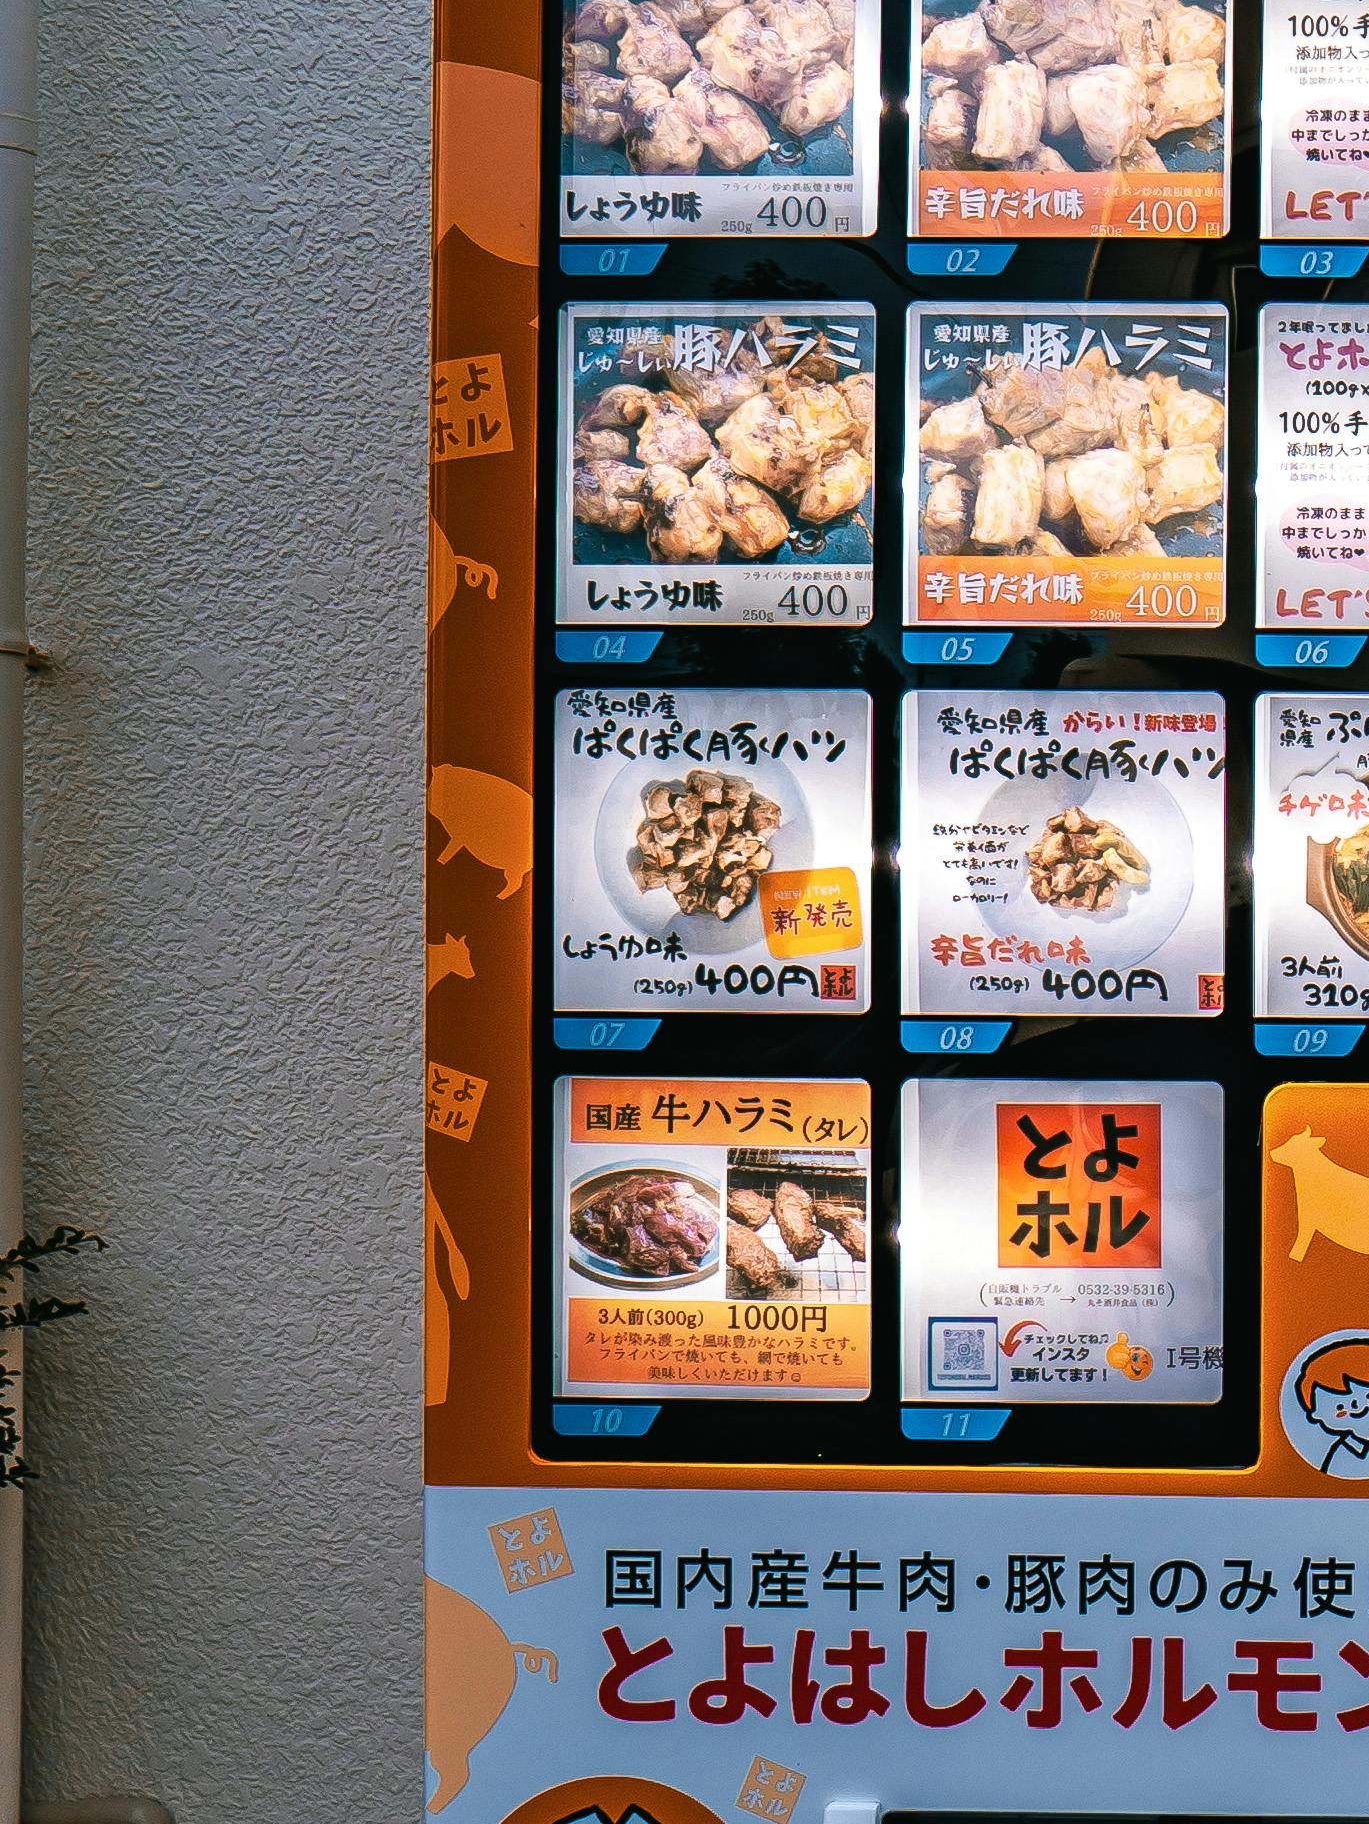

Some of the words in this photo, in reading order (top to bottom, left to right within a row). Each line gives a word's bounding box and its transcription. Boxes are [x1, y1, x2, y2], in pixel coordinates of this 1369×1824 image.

[566, 189, 703, 223] しょうゆ味
[925, 187, 1084, 220] 辛旨だれ味
[599, 247, 630, 272] 01
[947, 250, 980, 273] 02
[1301, 252, 1334, 274] 03
[672, 324, 862, 372] 豚ハラミ
[1023, 323, 1212, 371] 豚ハラミ
[1297, 507, 1366, 521] 冷凍のまま
[588, 580, 723, 612] しょうゆ味
[925, 572, 1083, 605] 辛旨だれ味
[743, 609, 774, 622] 250g
[593, 636, 626, 660] 04
[941, 638, 974, 661] 05
[1295, 640, 1329, 663] 06
[573, 721, 846, 765] ぱくぱく豚ハツ
[805, 884, 840, 897] ITEM
[966, 876, 996, 886] なのに
[770, 901, 853, 935] 新発売
[1281, 956, 1343, 979] 3人前
[634, 978, 692, 997] (250g)
[1043, 970, 1168, 1002] 400円
[589, 1022, 625, 1047] 07
[940, 1026, 973, 1050] 08
[1294, 1030, 1328, 1052] 09
[586, 1103, 641, 1131] 国産
[651, 1094, 795, 1133] 牛ハラミ
[1016, 1114, 1141, 1182] とよ
[1009, 1190, 1151, 1258] ホル
[1078, 1283, 1165, 1296] 0532-39-5316
[727, 1305, 828, 1333] 1000円
[1033, 1347, 1089, 1362] インスタ
[591, 1407, 623, 1432] 10
[940, 1413, 970, 1436] 11
